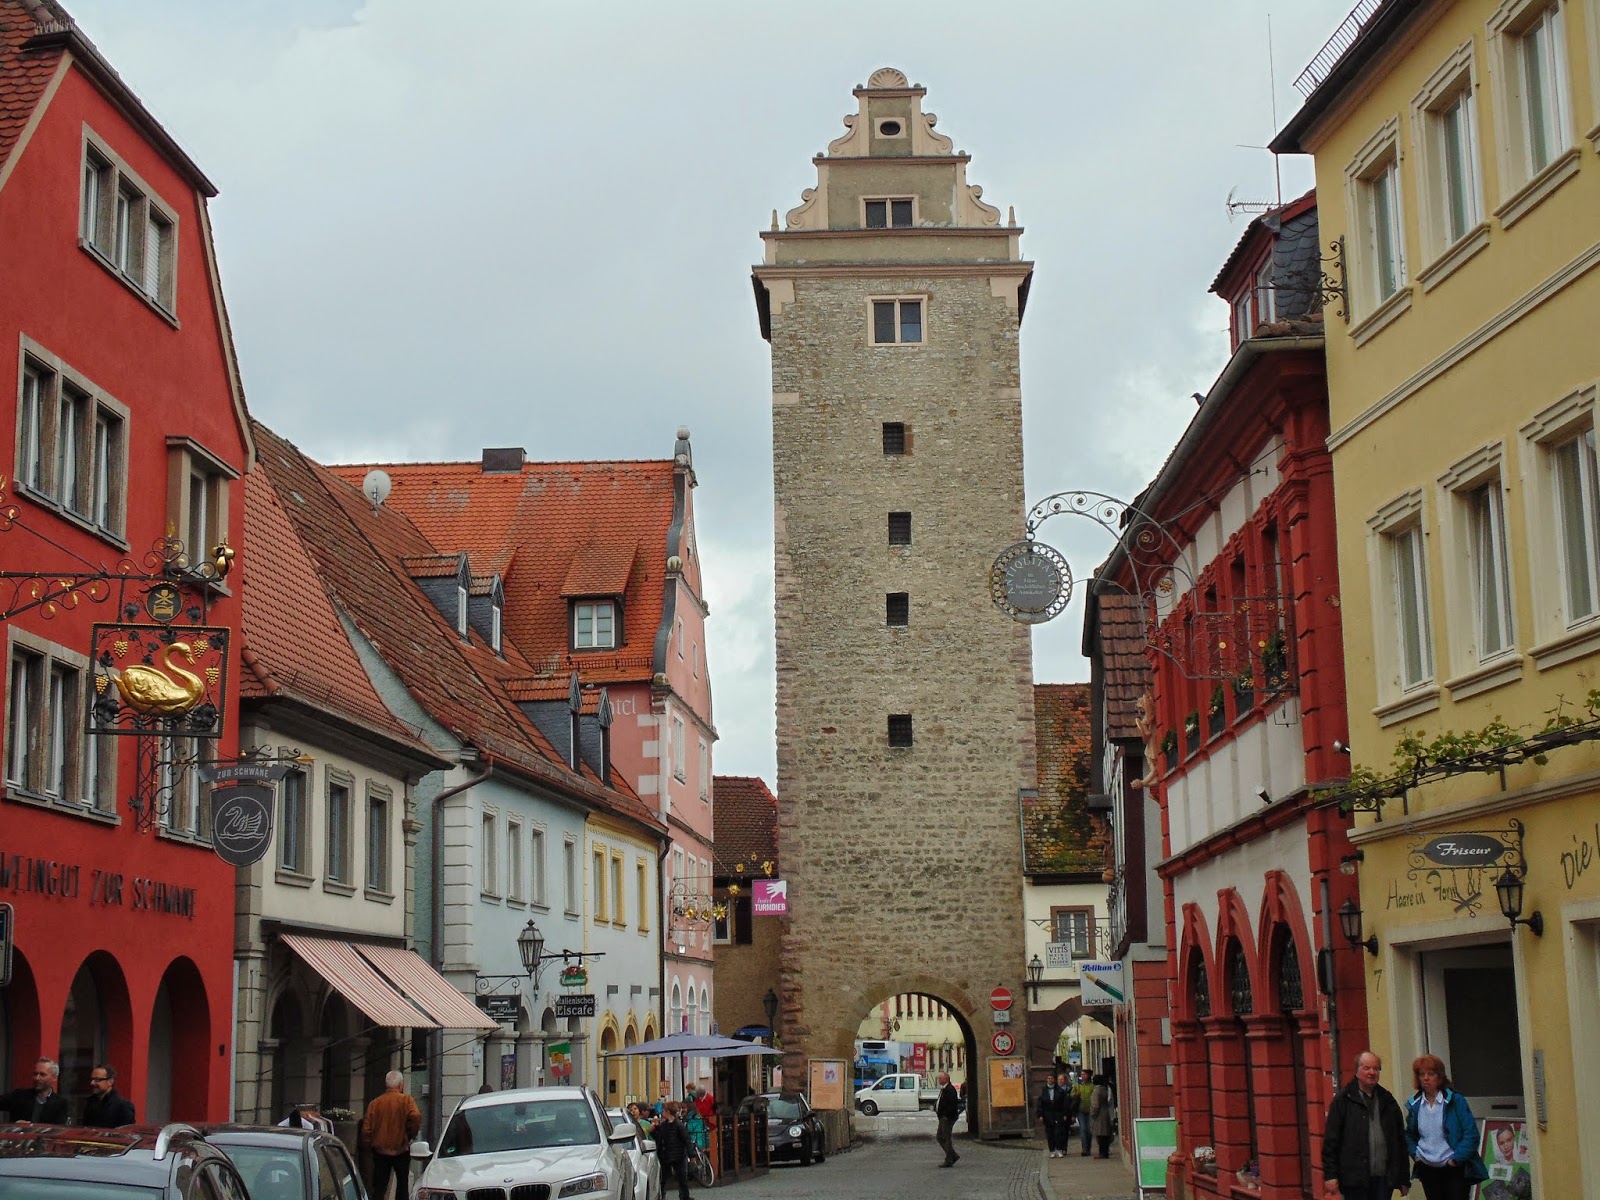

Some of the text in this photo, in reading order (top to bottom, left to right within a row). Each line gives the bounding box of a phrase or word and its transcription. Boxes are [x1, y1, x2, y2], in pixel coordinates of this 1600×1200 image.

[217, 767, 269, 779] ZUR SCHWANE
[1436, 842, 1491, 856] Friseur
[1561, 835, 1592, 889] Die
[0, 852, 197, 918] WEINGUT ZUR SCHWANE
[754, 903, 786, 912] TURMDIEB
[1082, 964, 1112, 972] Pelikan
[1374, 969, 1382, 992] 7
[557, 1004, 593, 1015] Eiscafe
